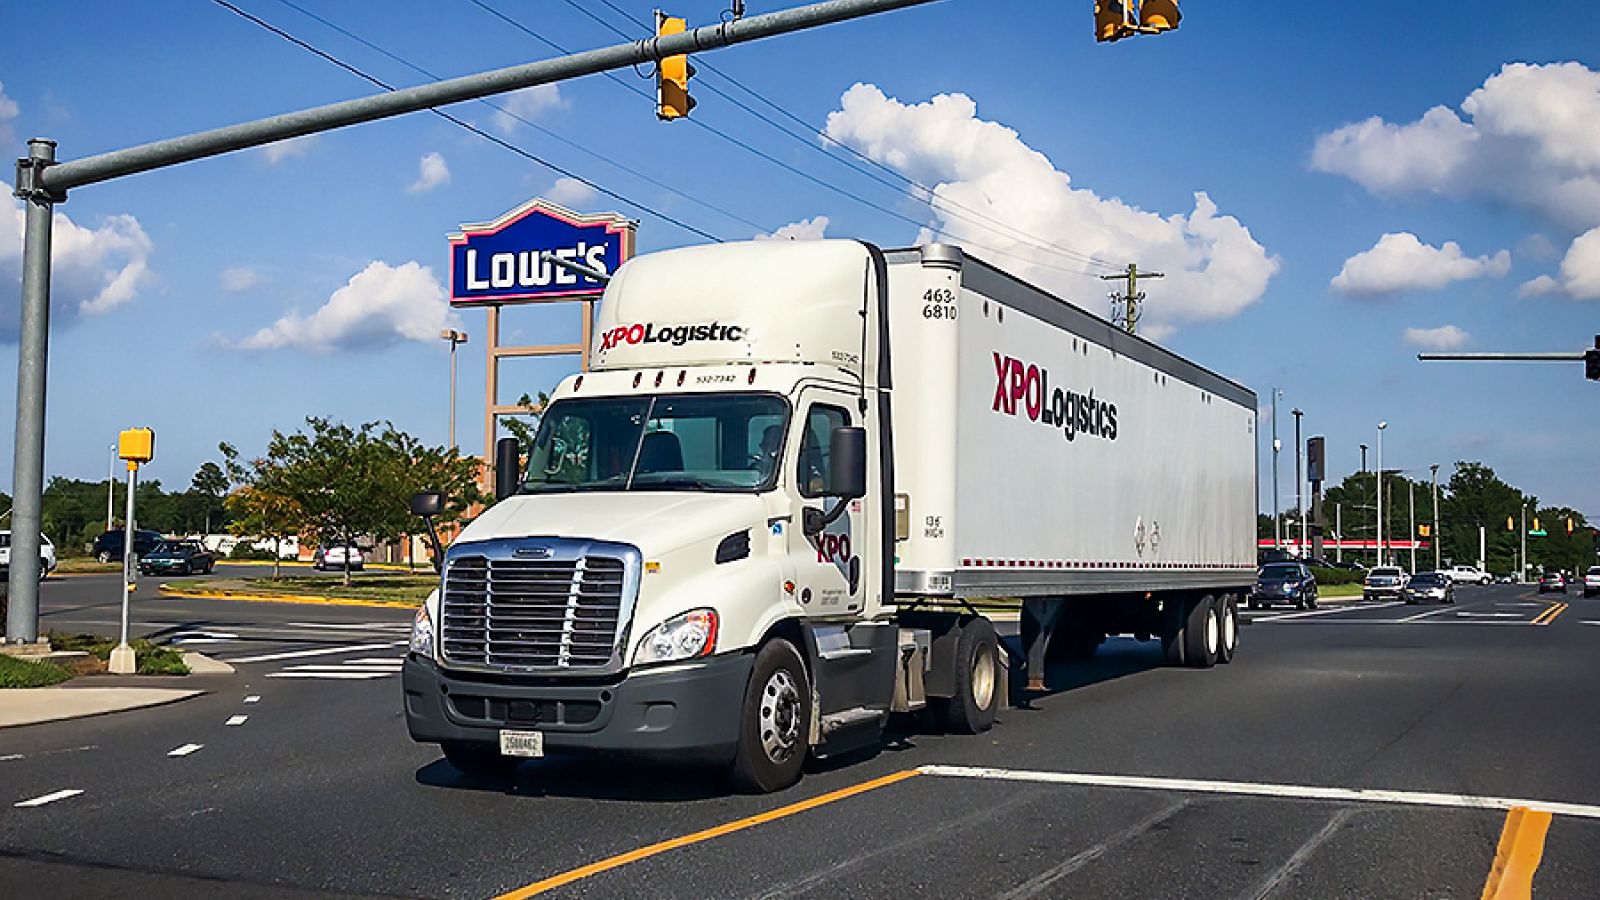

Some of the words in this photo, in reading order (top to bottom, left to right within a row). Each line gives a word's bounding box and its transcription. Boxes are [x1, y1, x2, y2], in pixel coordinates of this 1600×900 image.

[466, 242, 606, 290] LOWE'S
[922, 304, 957, 320] 6810
[814, 533, 851, 563] XPO
